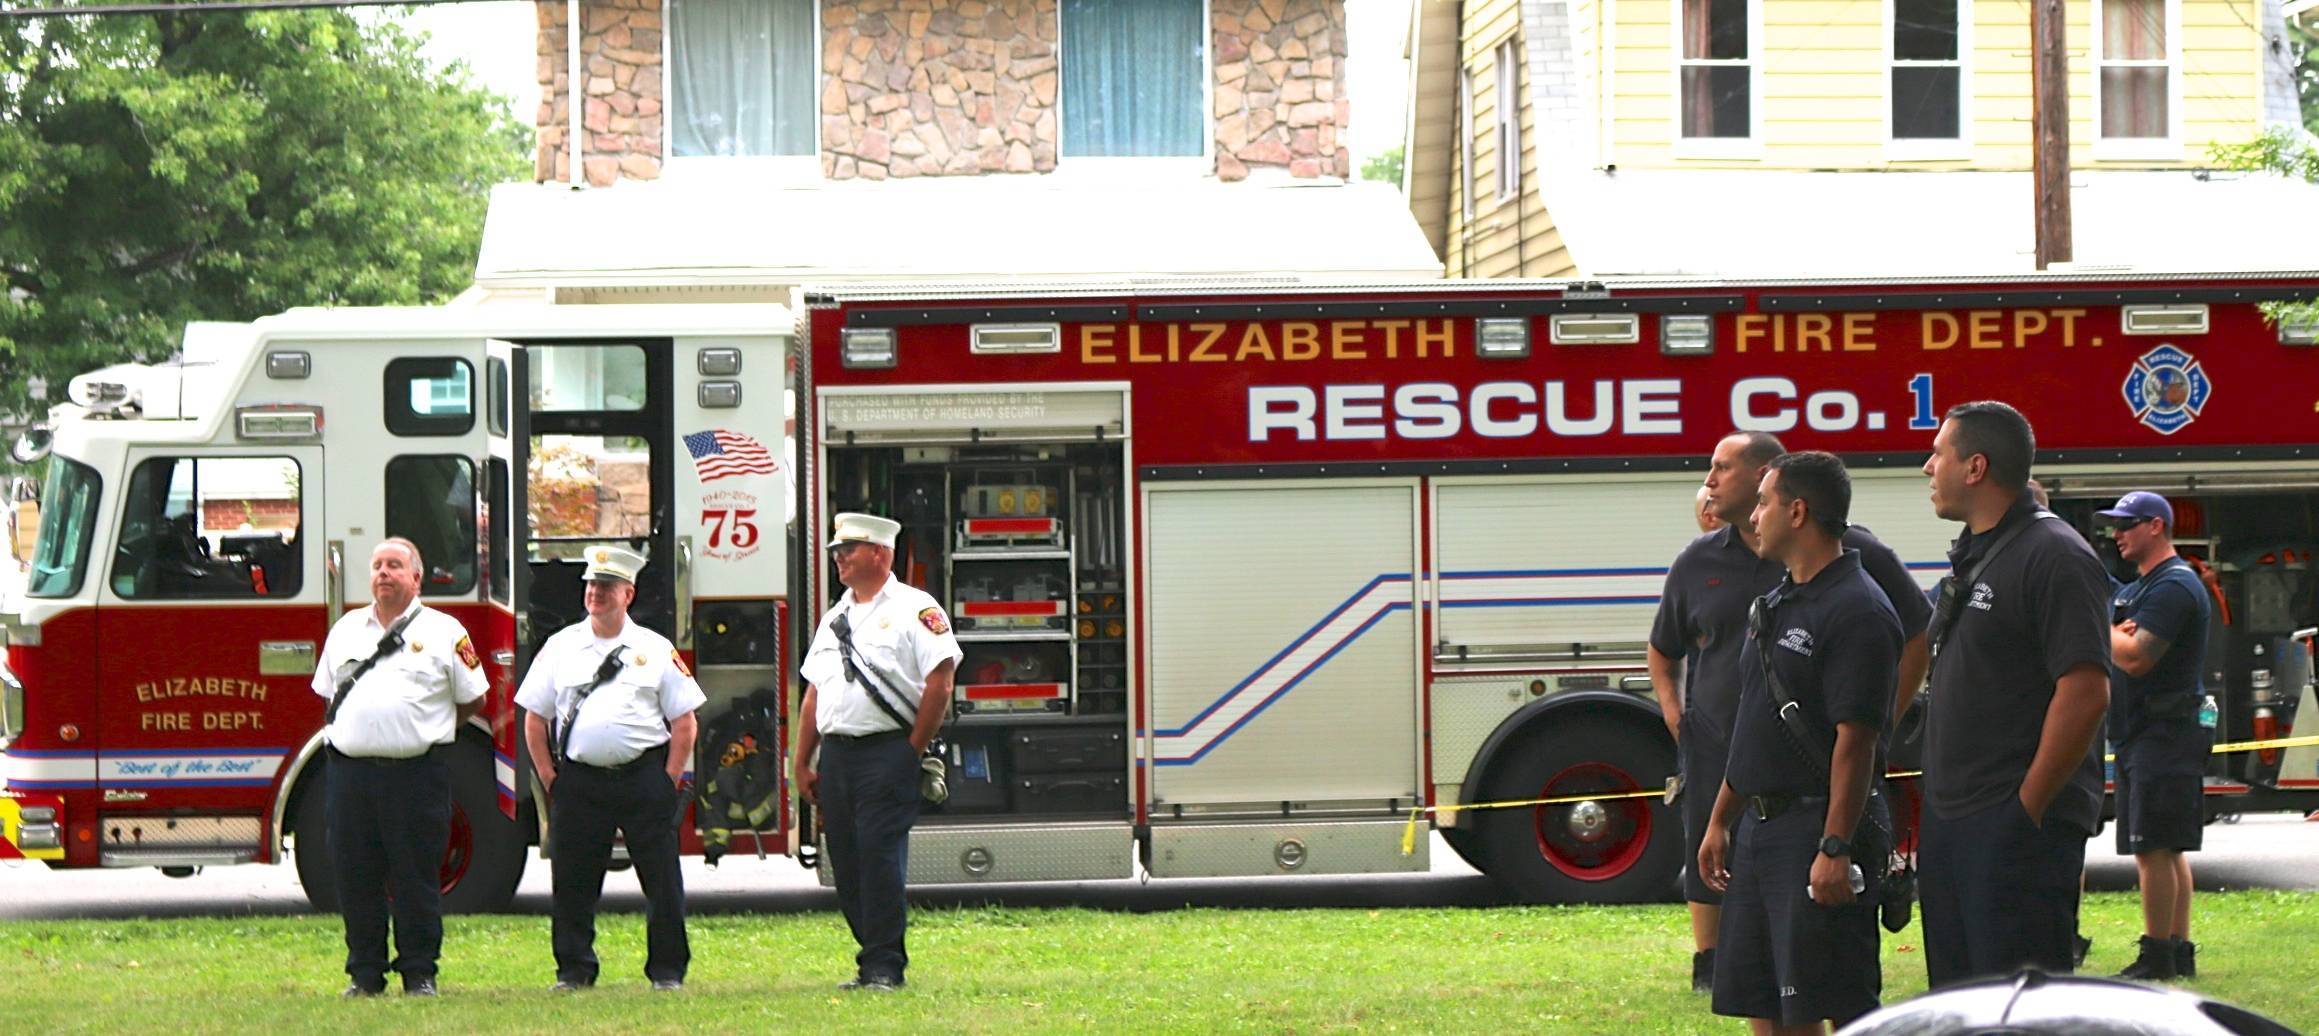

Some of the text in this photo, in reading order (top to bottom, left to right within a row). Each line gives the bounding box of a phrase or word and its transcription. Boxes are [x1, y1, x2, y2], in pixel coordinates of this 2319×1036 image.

[1081, 309, 2102, 363] ELIZABETH FIRE DEPT.
[856, 408, 920, 422] DEPARTMENT
[922, 408, 937, 421] OF
[941, 407, 993, 420] HOMELAND
[998, 405, 1045, 419] SECURITY
[1248, 373, 1939, 441] RESCUE Co. 1
[701, 509, 758, 548] 75
[1786, 628, 1813, 646] ELIZABETH
[136, 677, 267, 702] ELIZABETH
[142, 711, 264, 730] FIRE DEPT.
